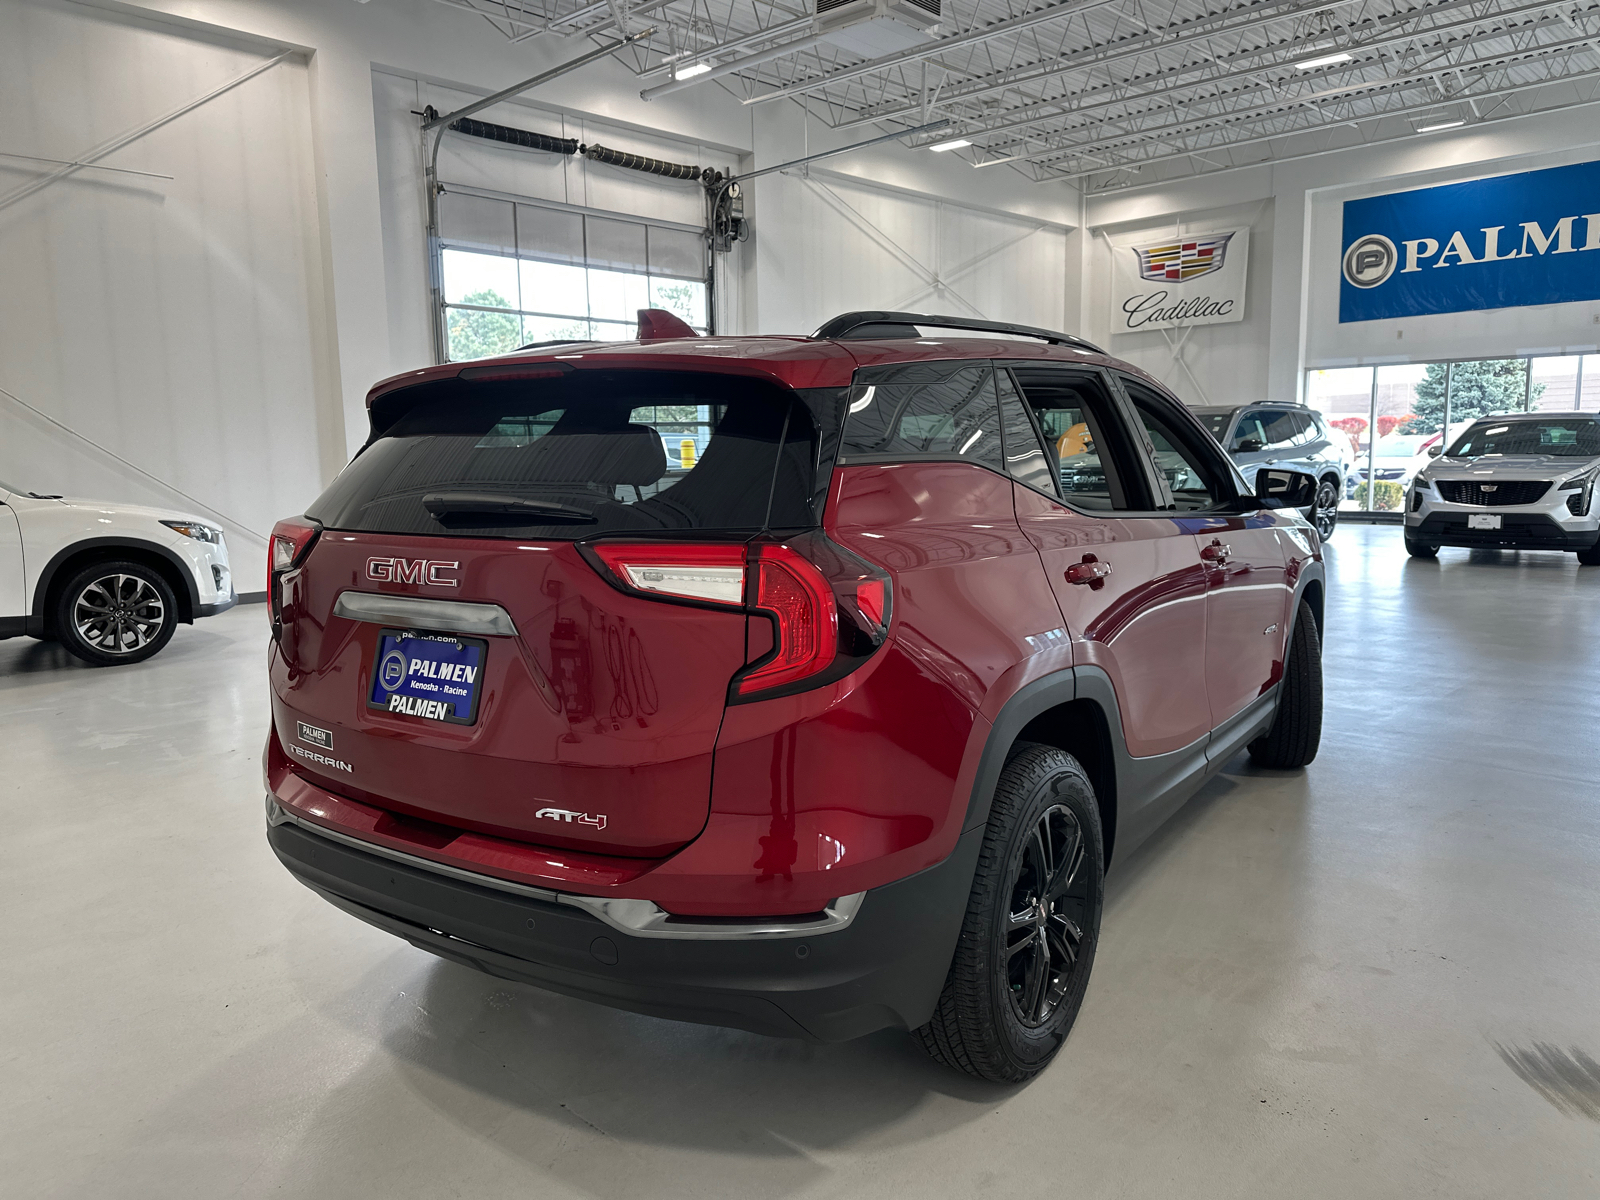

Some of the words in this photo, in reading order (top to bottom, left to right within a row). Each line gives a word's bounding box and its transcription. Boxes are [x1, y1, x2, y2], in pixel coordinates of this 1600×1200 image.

[1122, 290, 1234, 328] Cadillac
[365, 556, 459, 587] GMC
[402, 632, 457, 644] pan.com
[408, 658, 478, 684] PALMEN
[410, 679, 439, 692] Kenosha
[443, 684, 468, 696] Racine
[388, 694, 448, 721] PALMEN
[302, 725, 326, 741] PALMEN
[289, 743, 353, 773] TERRAIN
[535, 807, 607, 831] AT4
